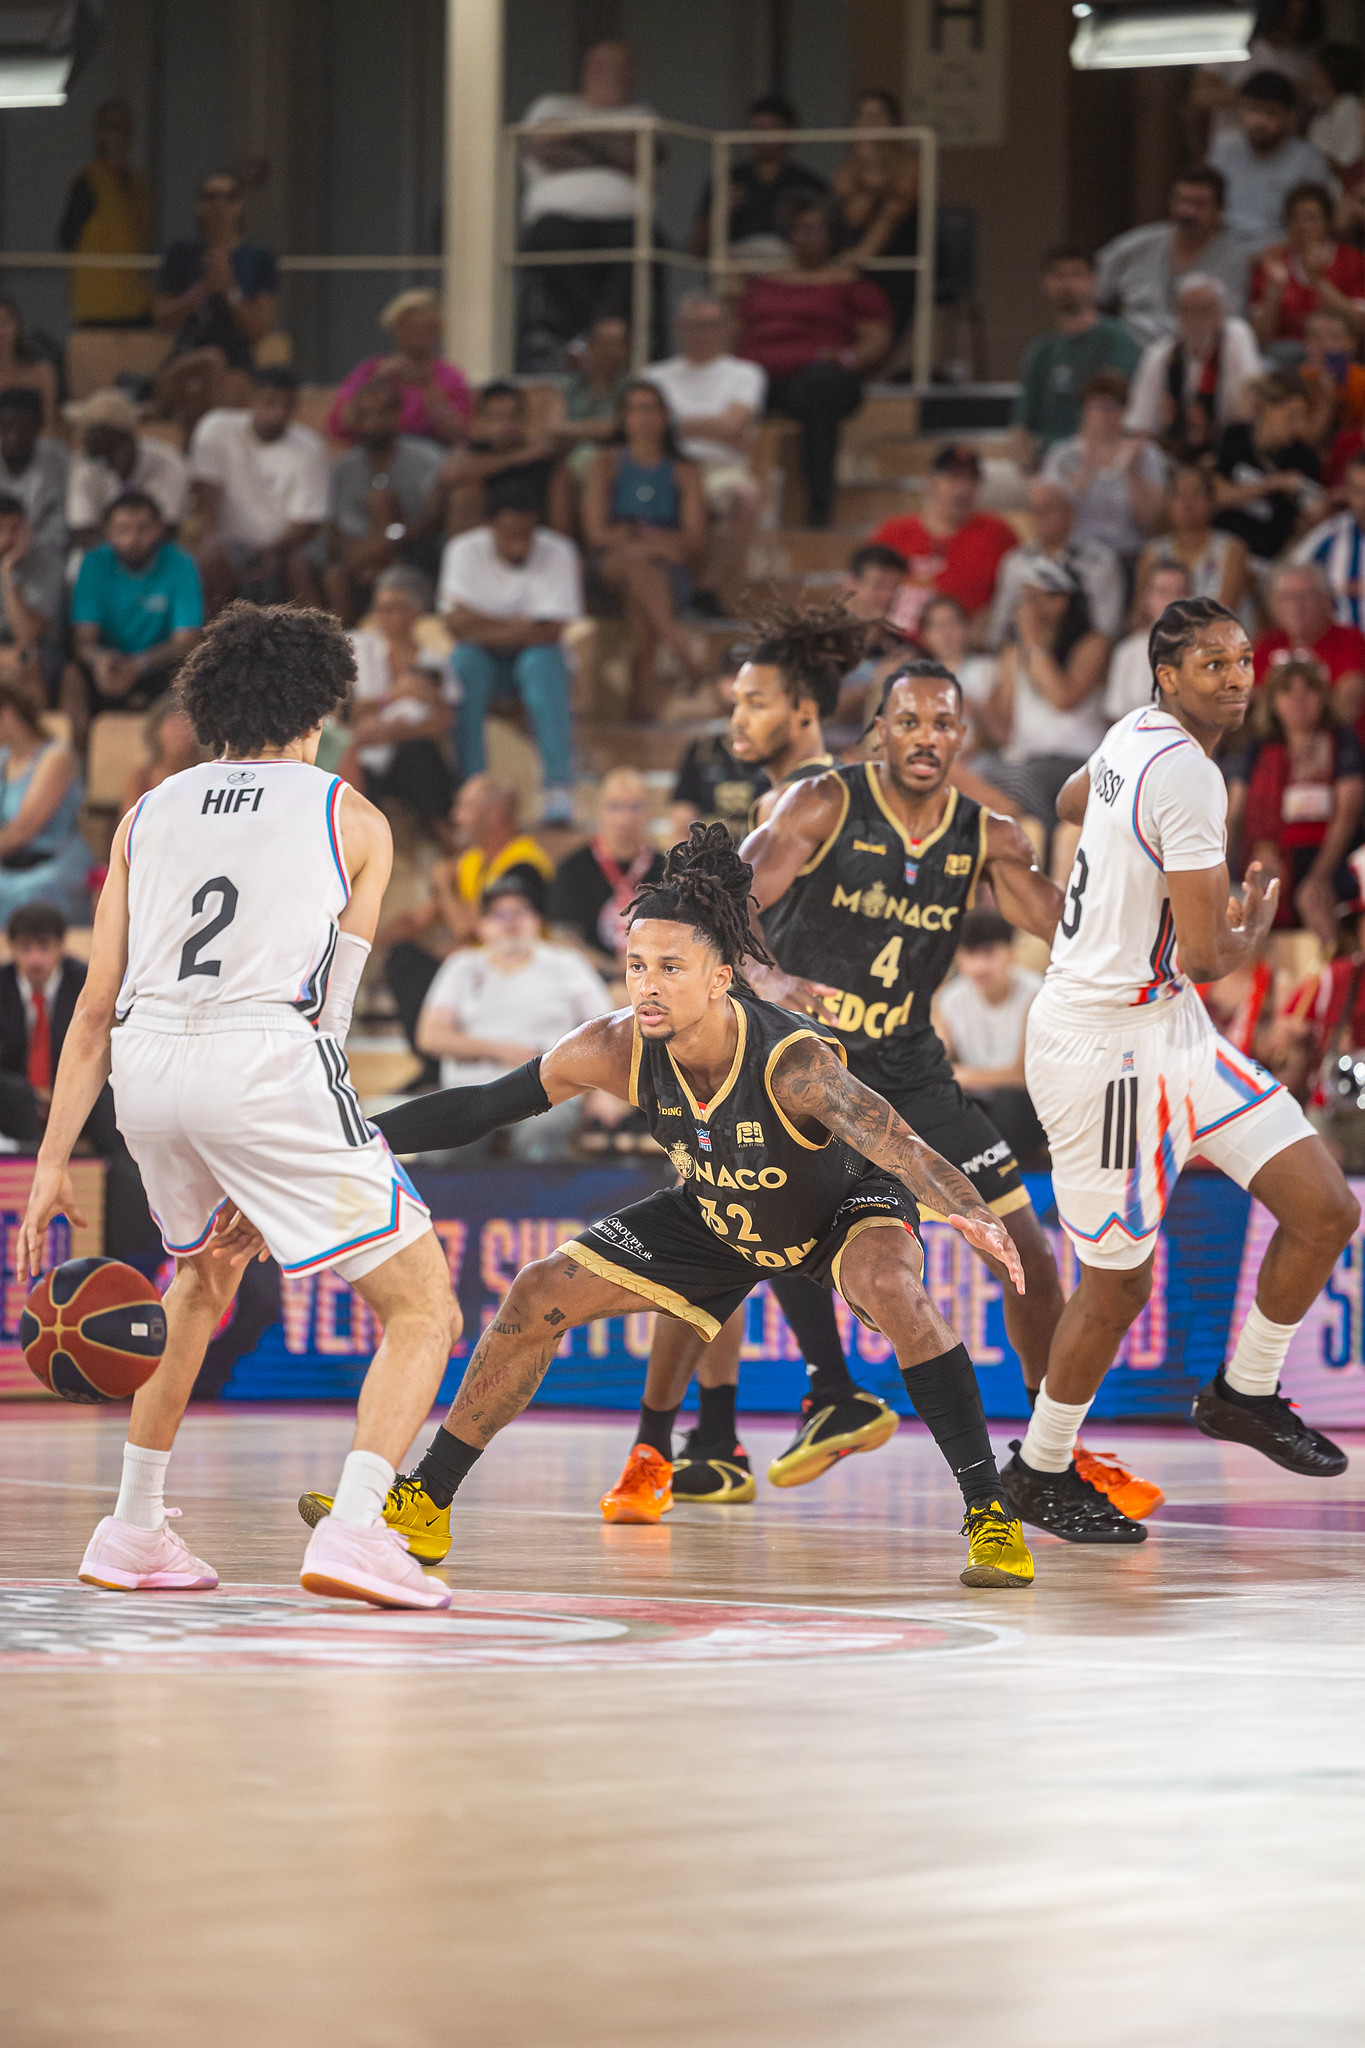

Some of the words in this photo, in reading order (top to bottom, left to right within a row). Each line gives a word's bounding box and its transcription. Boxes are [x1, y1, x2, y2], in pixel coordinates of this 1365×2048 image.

[201, 787, 265, 815] HIFI
[177, 875, 239, 982] 2
[869, 935, 904, 989] 4
[696, 1195, 762, 1242] 32
